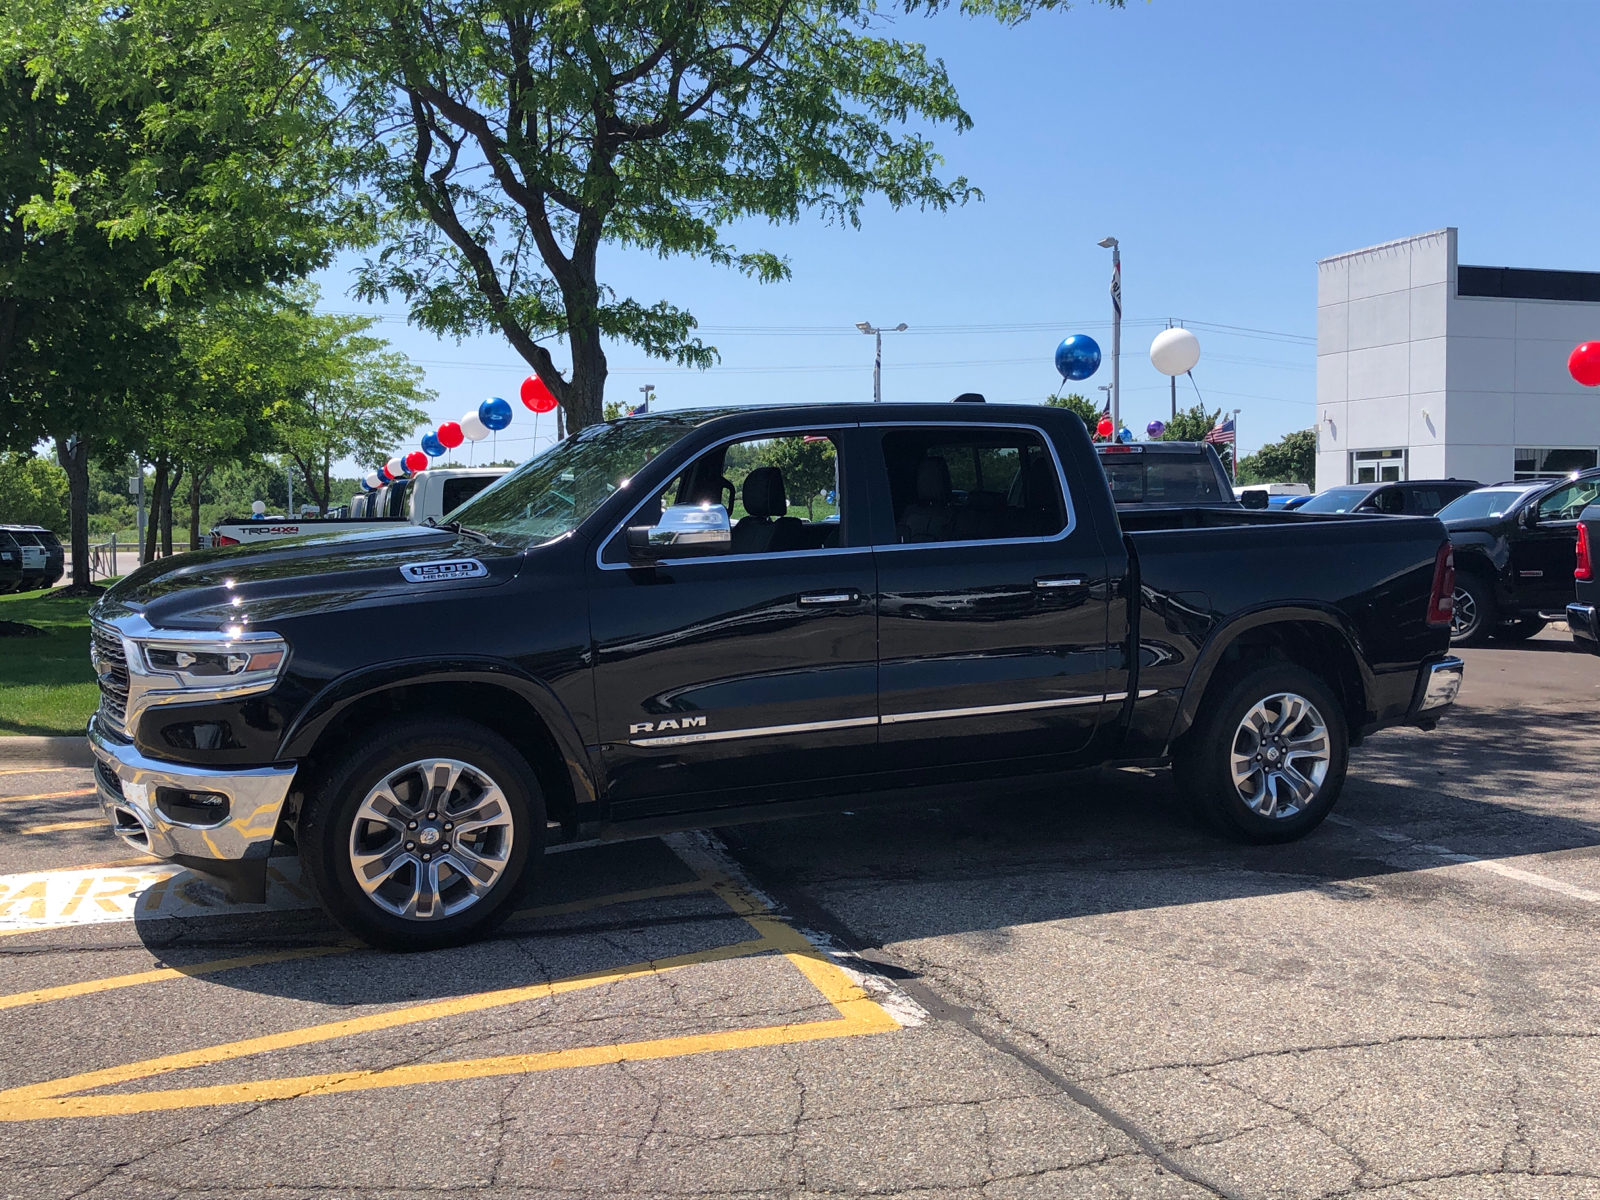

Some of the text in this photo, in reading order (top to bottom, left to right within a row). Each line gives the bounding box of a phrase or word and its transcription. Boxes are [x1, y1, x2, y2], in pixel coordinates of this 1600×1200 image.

[413, 563, 473, 575] 1500
[629, 716, 707, 734] RAM
[645, 735, 707, 744] LIMITED
